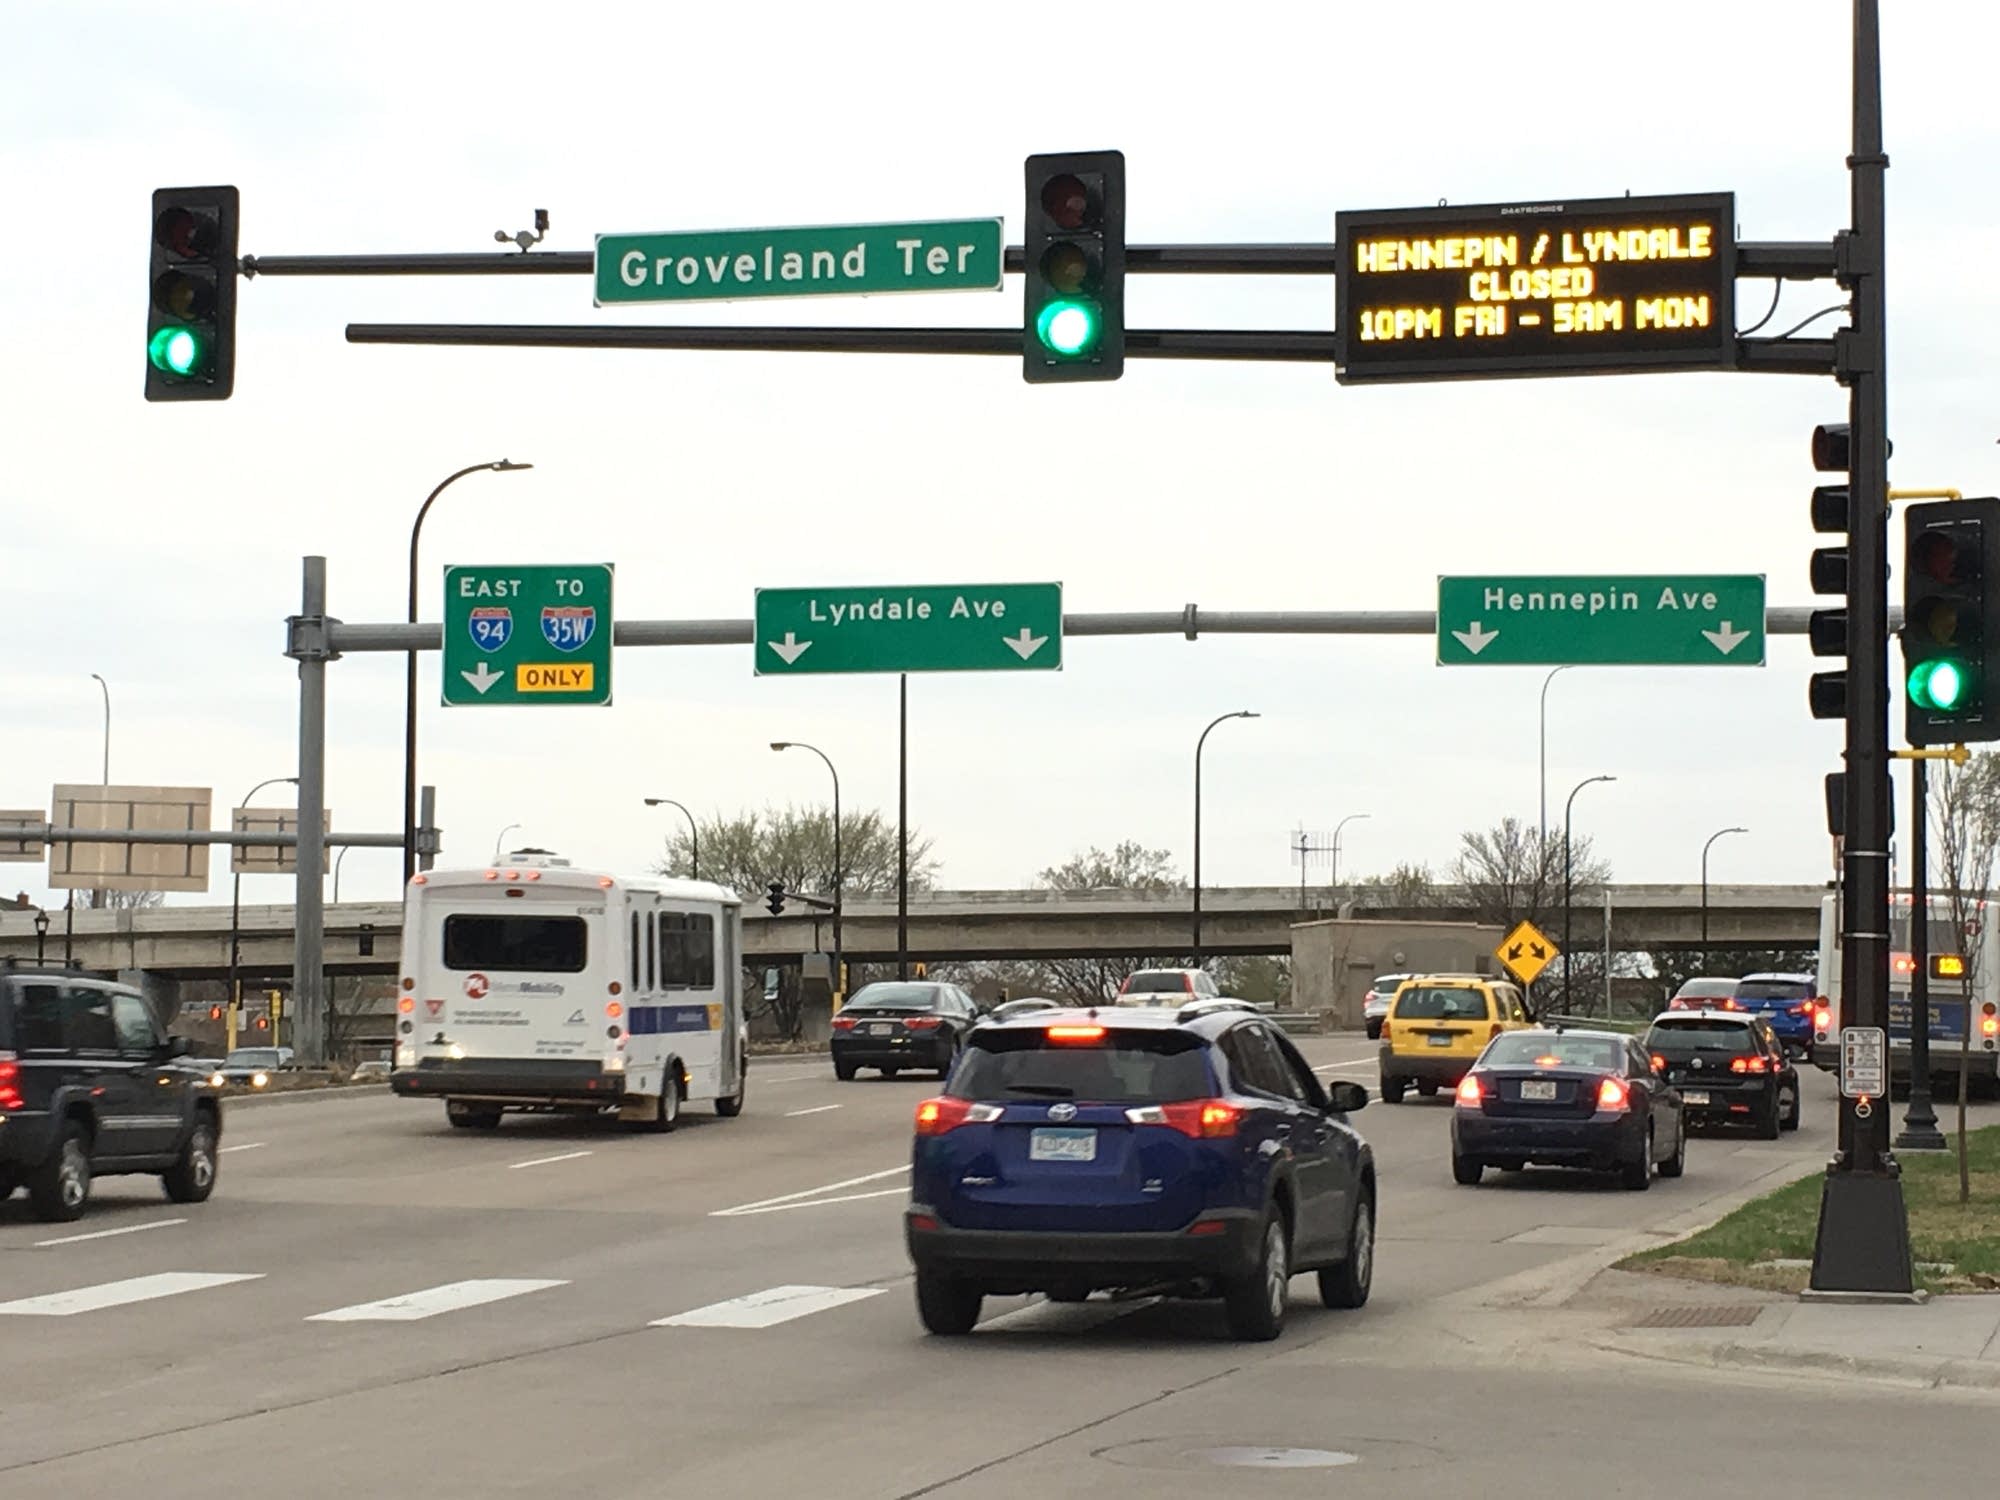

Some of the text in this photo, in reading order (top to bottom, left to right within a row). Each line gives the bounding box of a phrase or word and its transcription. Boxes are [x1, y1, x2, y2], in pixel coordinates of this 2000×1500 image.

[619, 239, 976, 287] Groveland Ter
[1357, 226, 1711, 273] HENNEPIN / LYNDALE
[1469, 267, 1594, 301] CLOSED
[1360, 307, 1442, 341] 10PM
[1454, 305, 1507, 337] FRI
[1553, 300, 1623, 333] 5AM
[1636, 296, 1709, 330] MON
[460, 577, 584, 597] EAST TO
[1484, 586, 1718, 616] Hennepin Ave
[809, 596, 1007, 626] Lyndale Ave
[476, 617, 588, 643] 94 35W
[526, 669, 586, 687] ONLY
